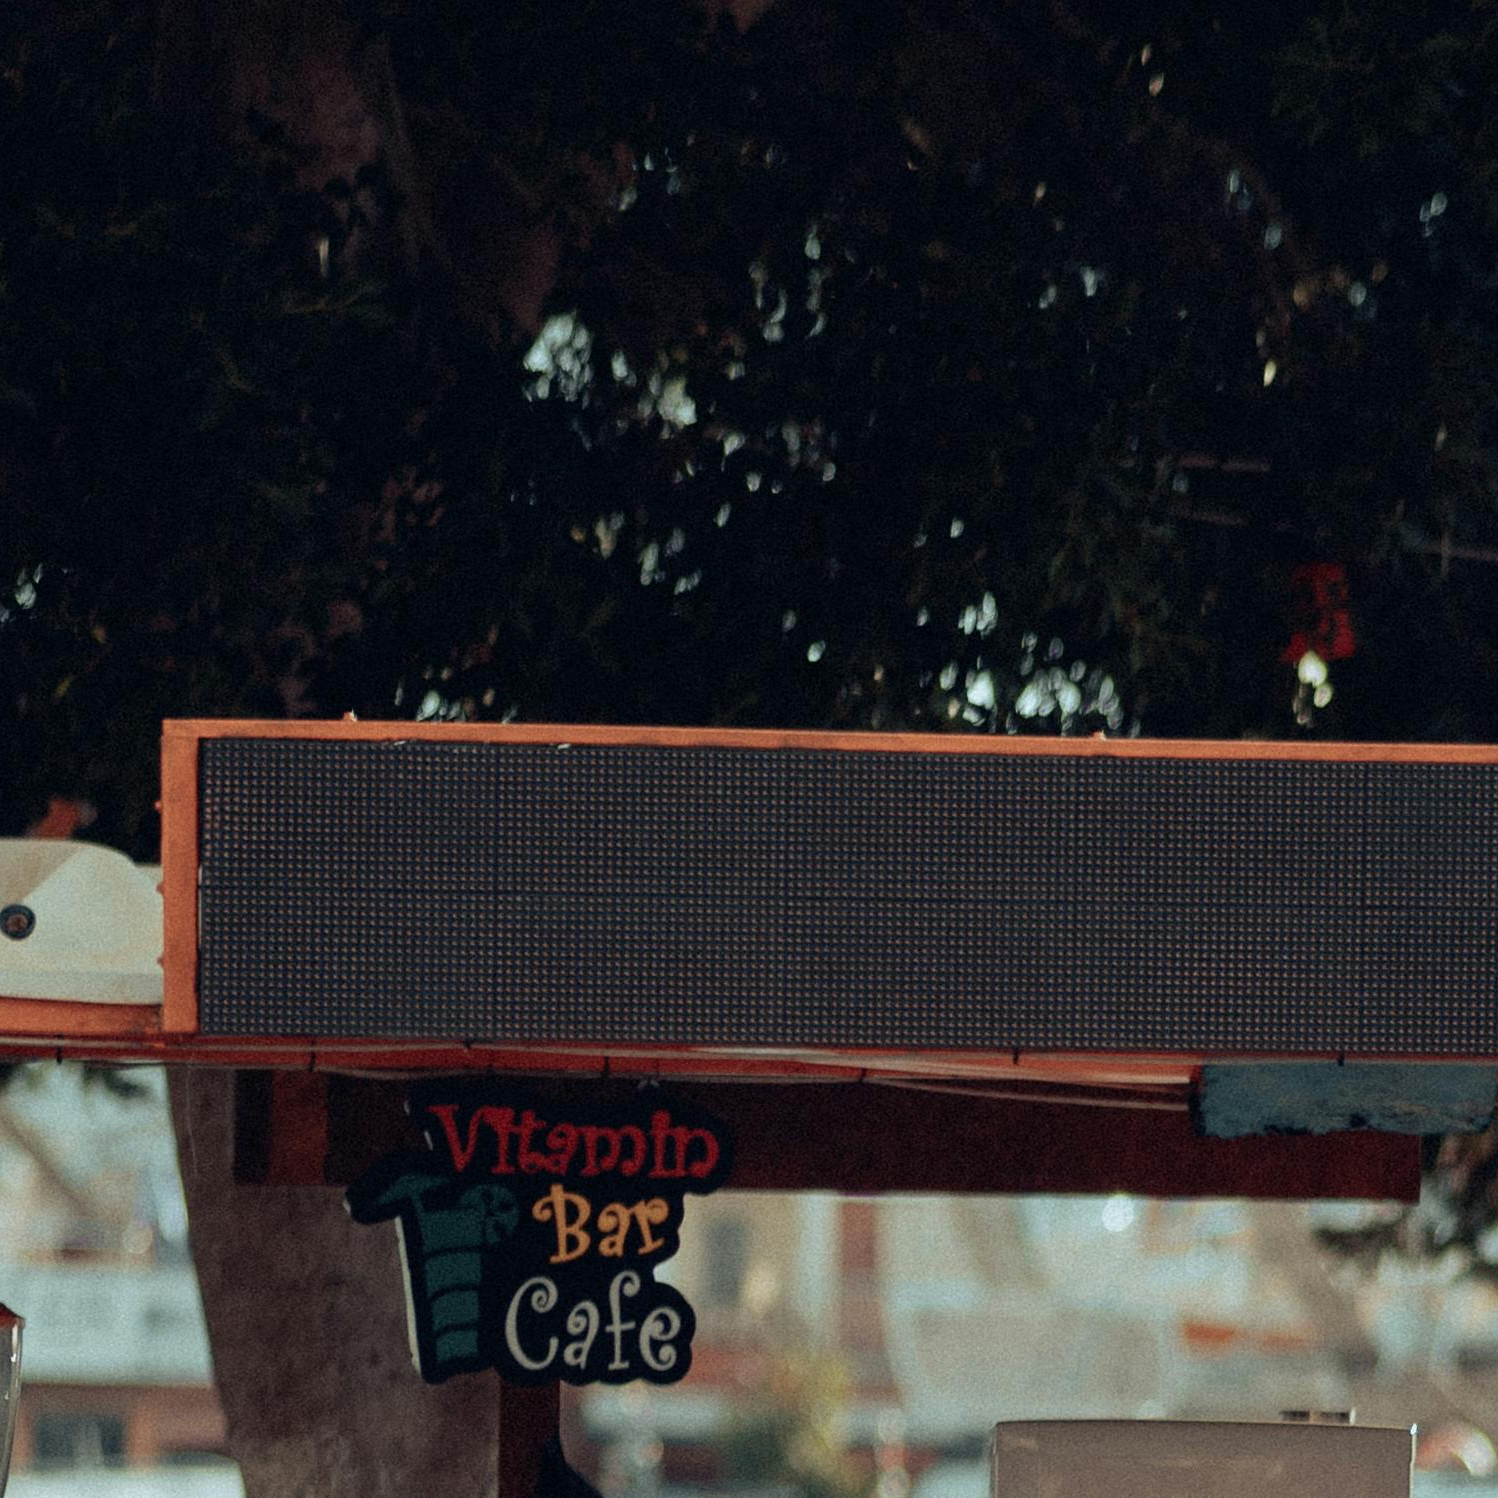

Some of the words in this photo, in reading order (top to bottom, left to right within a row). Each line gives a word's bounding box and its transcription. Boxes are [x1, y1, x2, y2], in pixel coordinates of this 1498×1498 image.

[424, 1104, 720, 1179] Vitamin
[531, 1182, 670, 1265] Bar
[505, 1269, 682, 1372] Cafe
